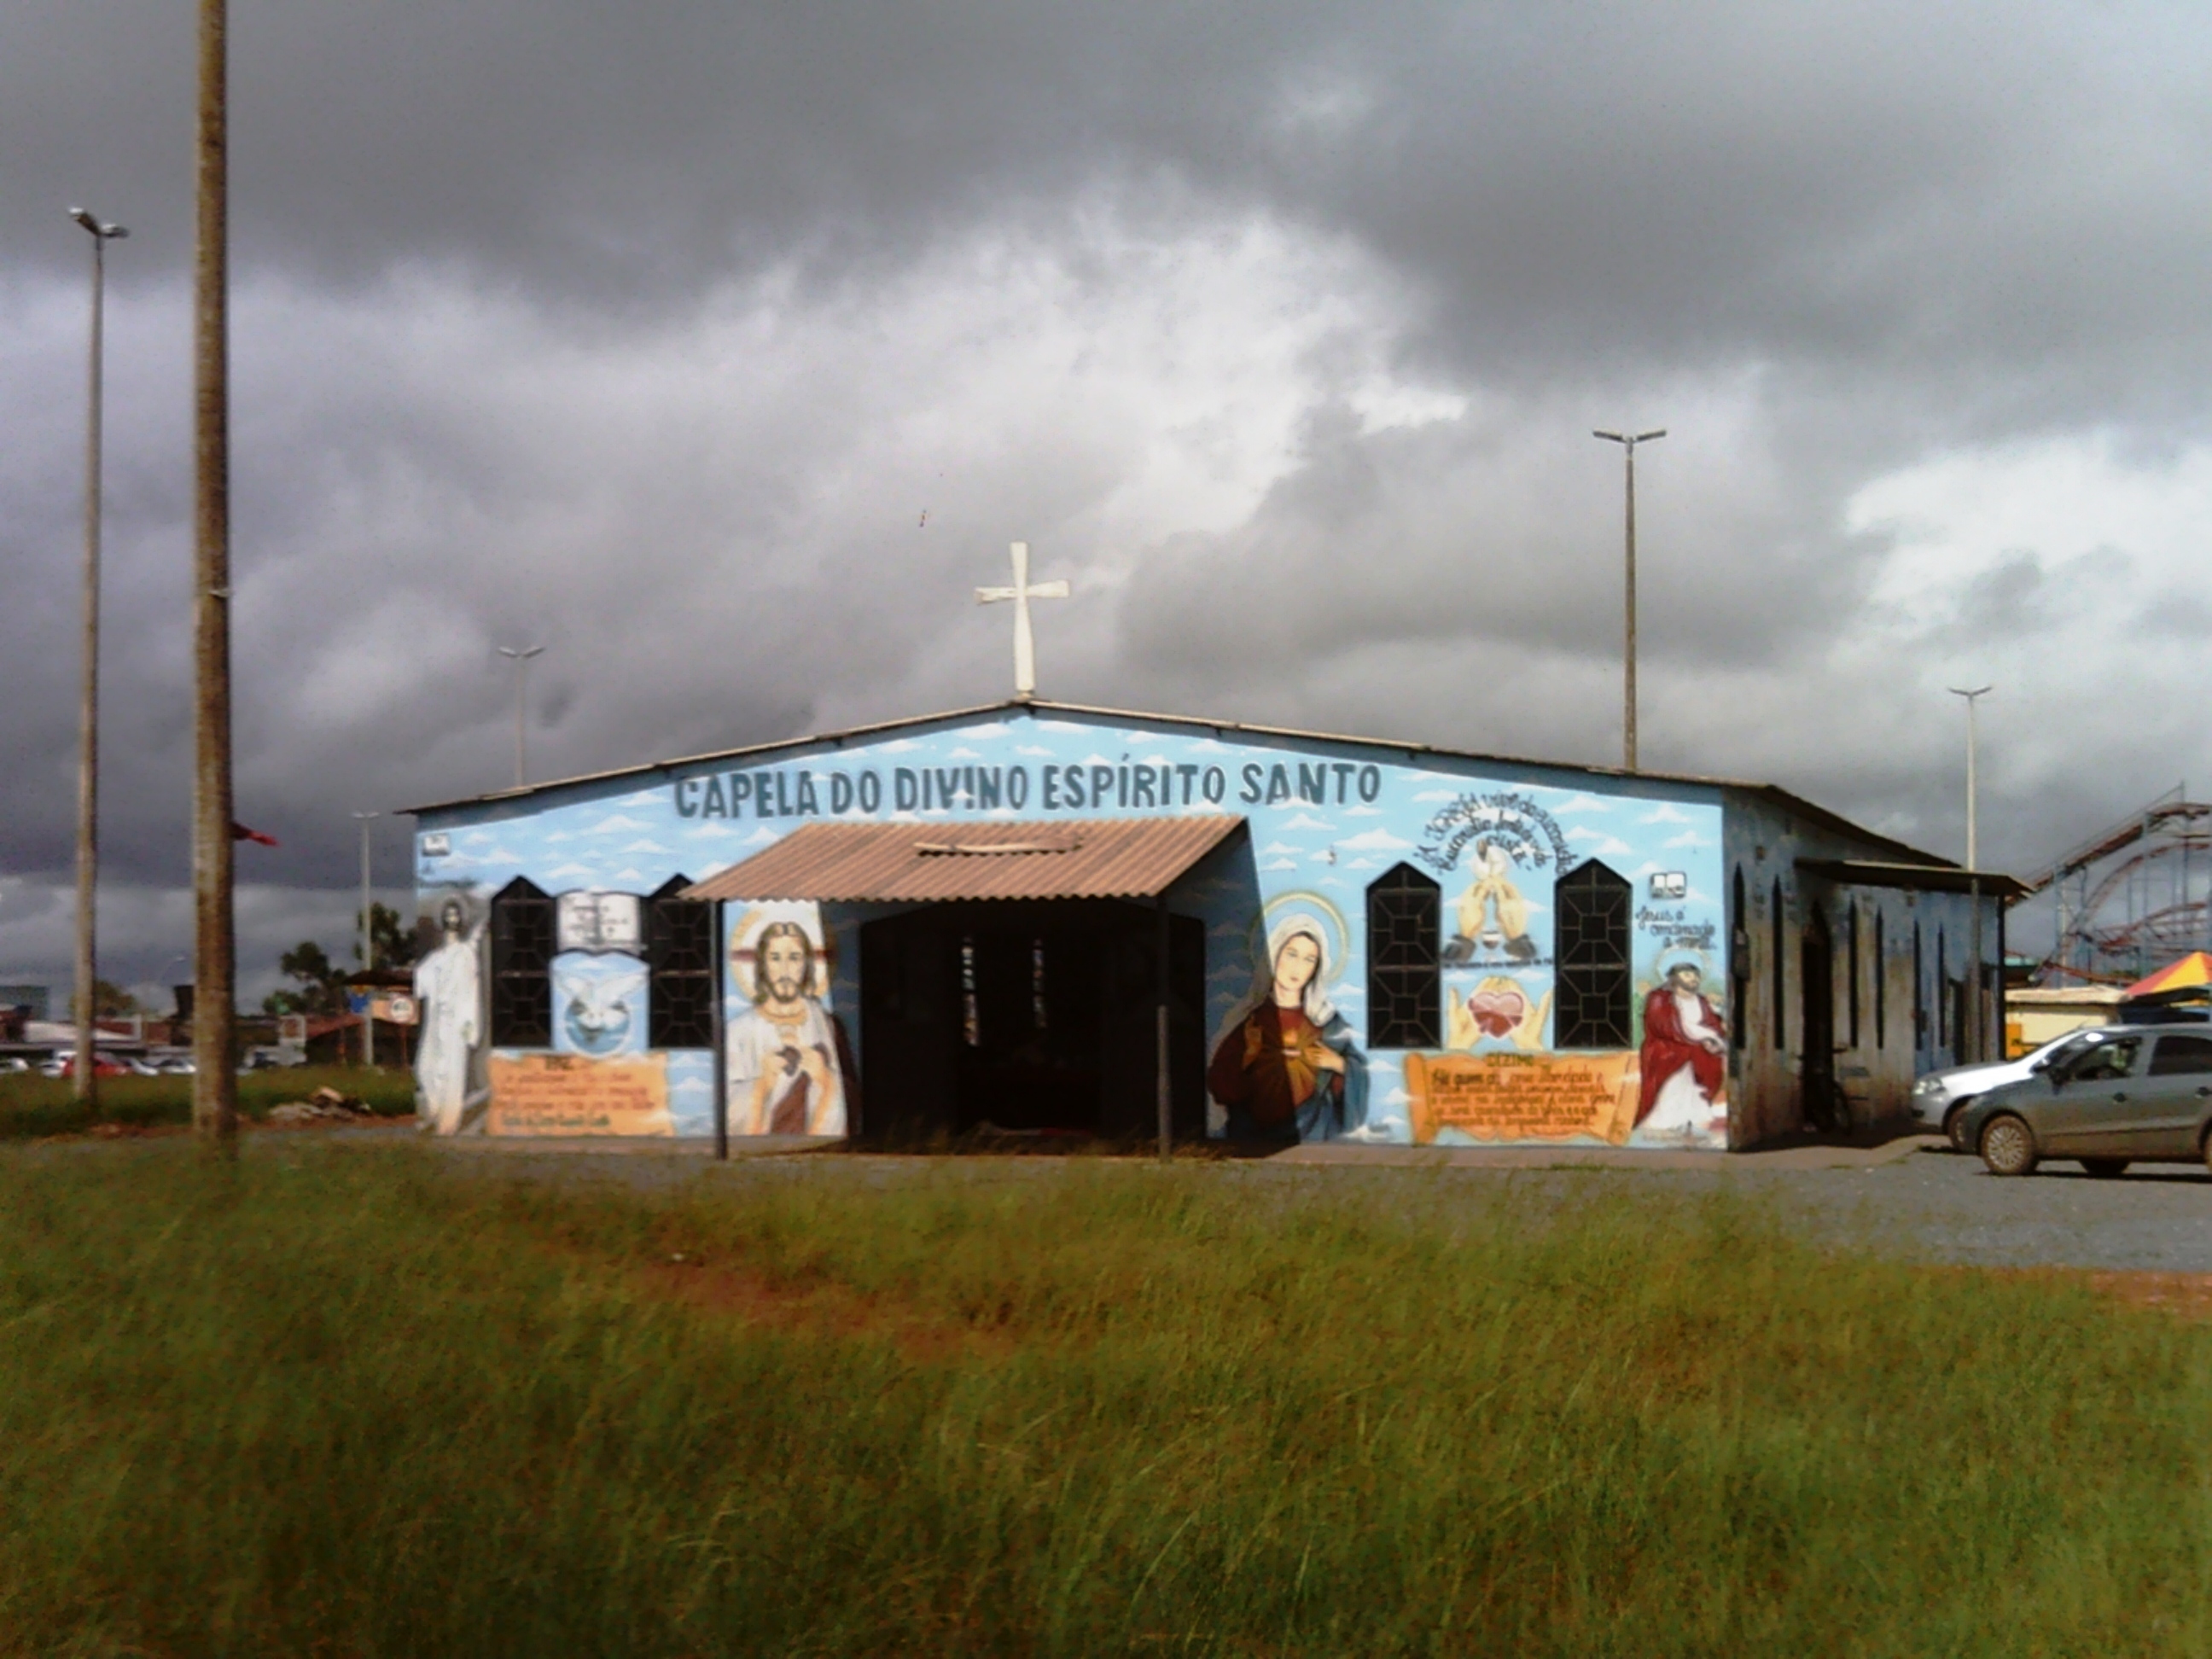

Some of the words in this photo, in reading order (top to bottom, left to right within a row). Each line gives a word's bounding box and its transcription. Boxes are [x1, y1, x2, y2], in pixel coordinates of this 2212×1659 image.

[674, 771, 820, 818] CAPELA
[830, 770, 882, 814] DO
[894, 765, 1028, 812] DIVINO
[1042, 753, 1225, 810] ESPÍRITO
[1239, 763, 1381, 805] SANTO
